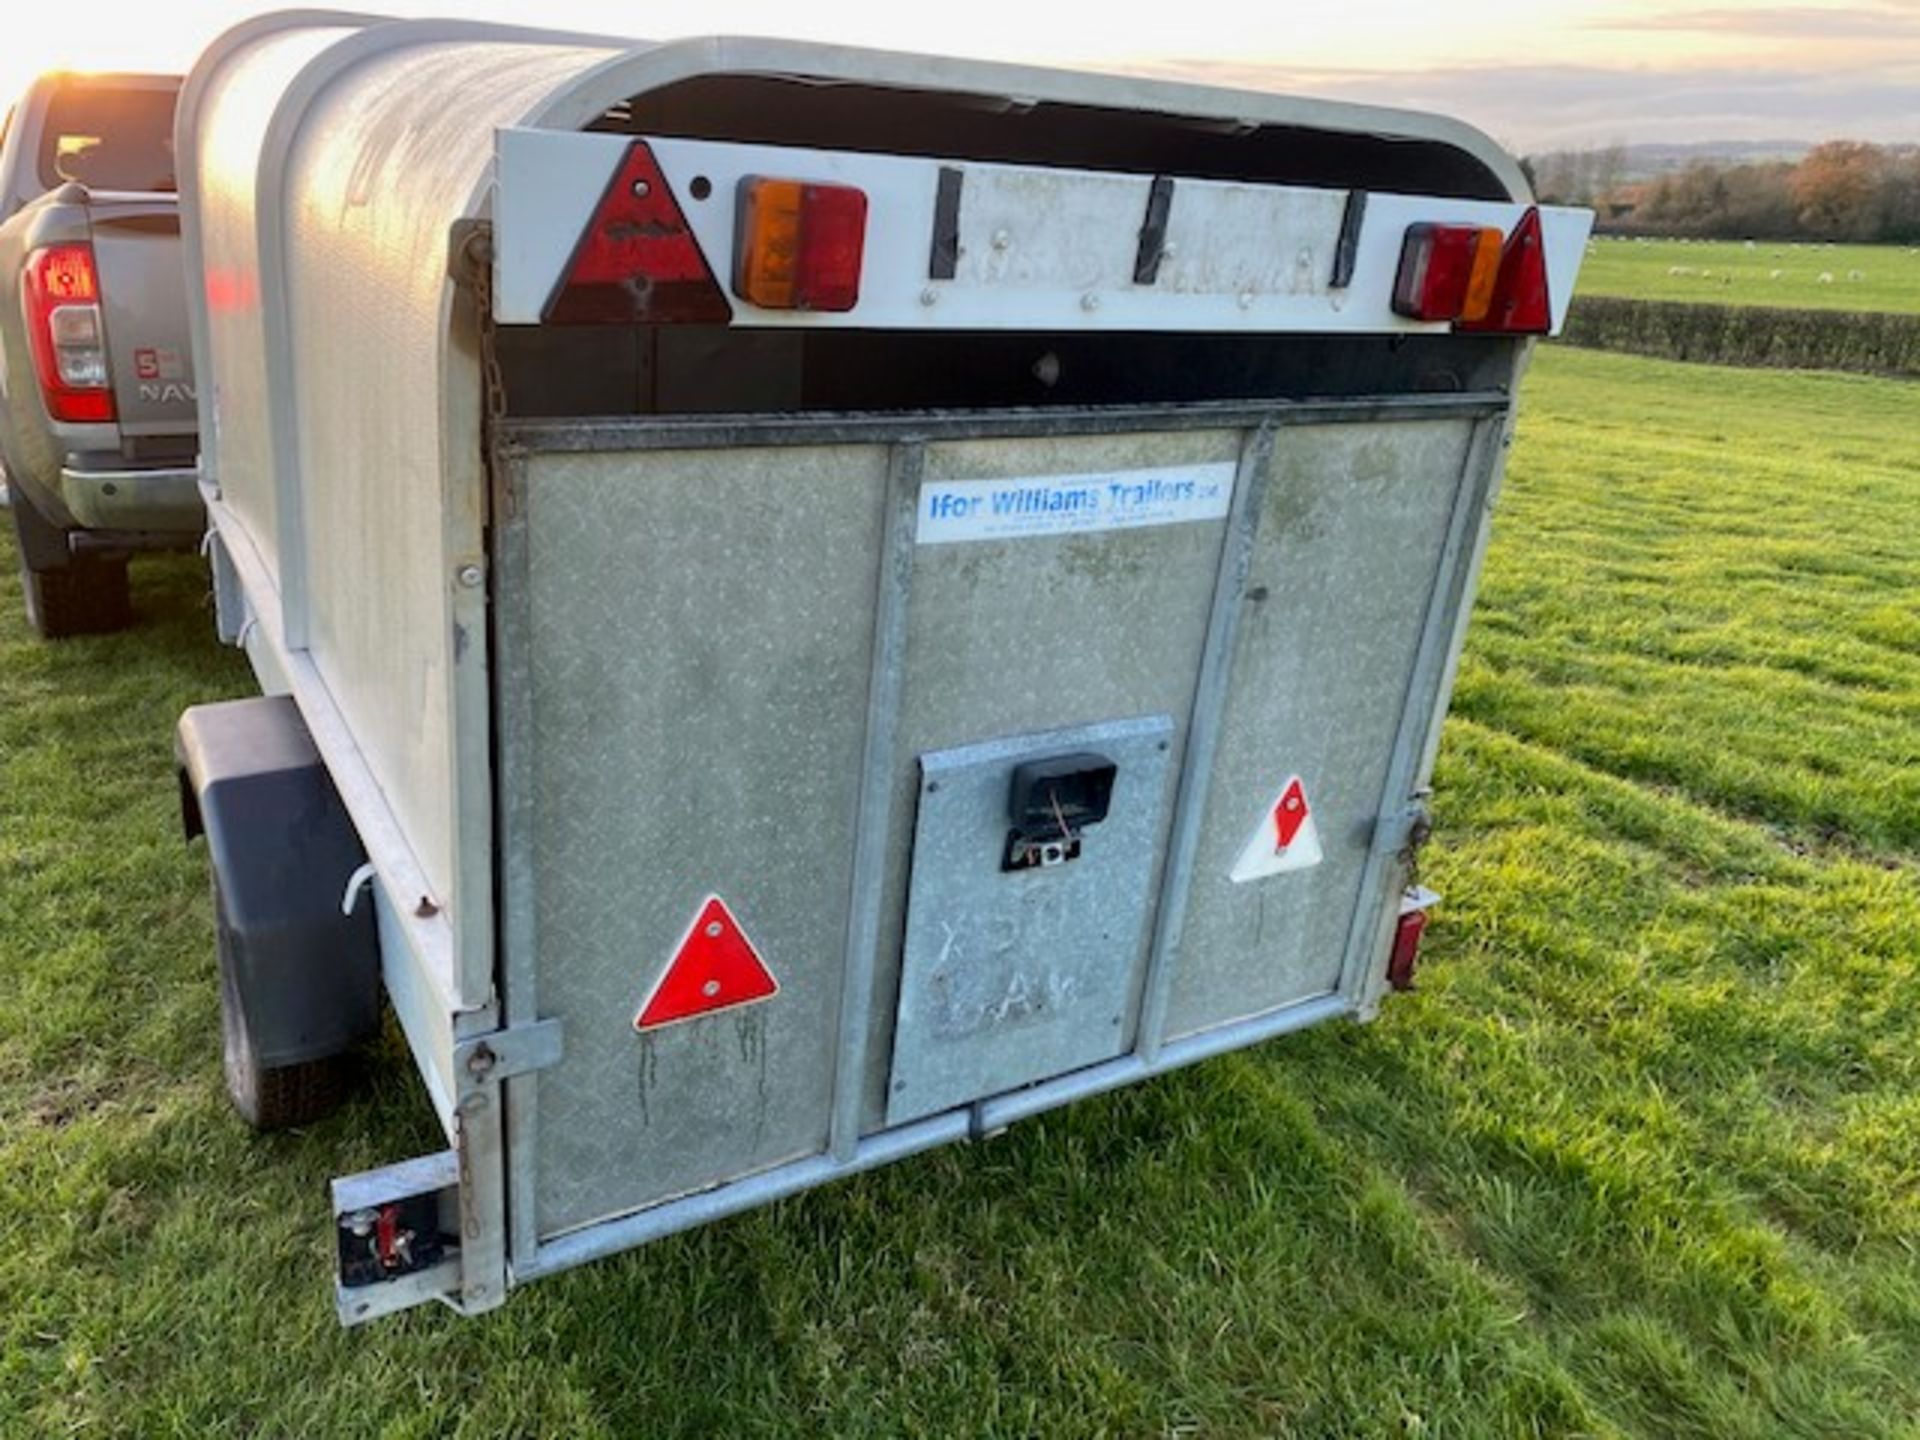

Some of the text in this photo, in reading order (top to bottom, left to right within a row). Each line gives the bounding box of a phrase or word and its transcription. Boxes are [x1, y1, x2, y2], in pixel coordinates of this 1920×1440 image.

[929, 492, 984, 519] Ifor
[991, 486, 1099, 515] Williams
[1107, 478, 1195, 506] Trailers
